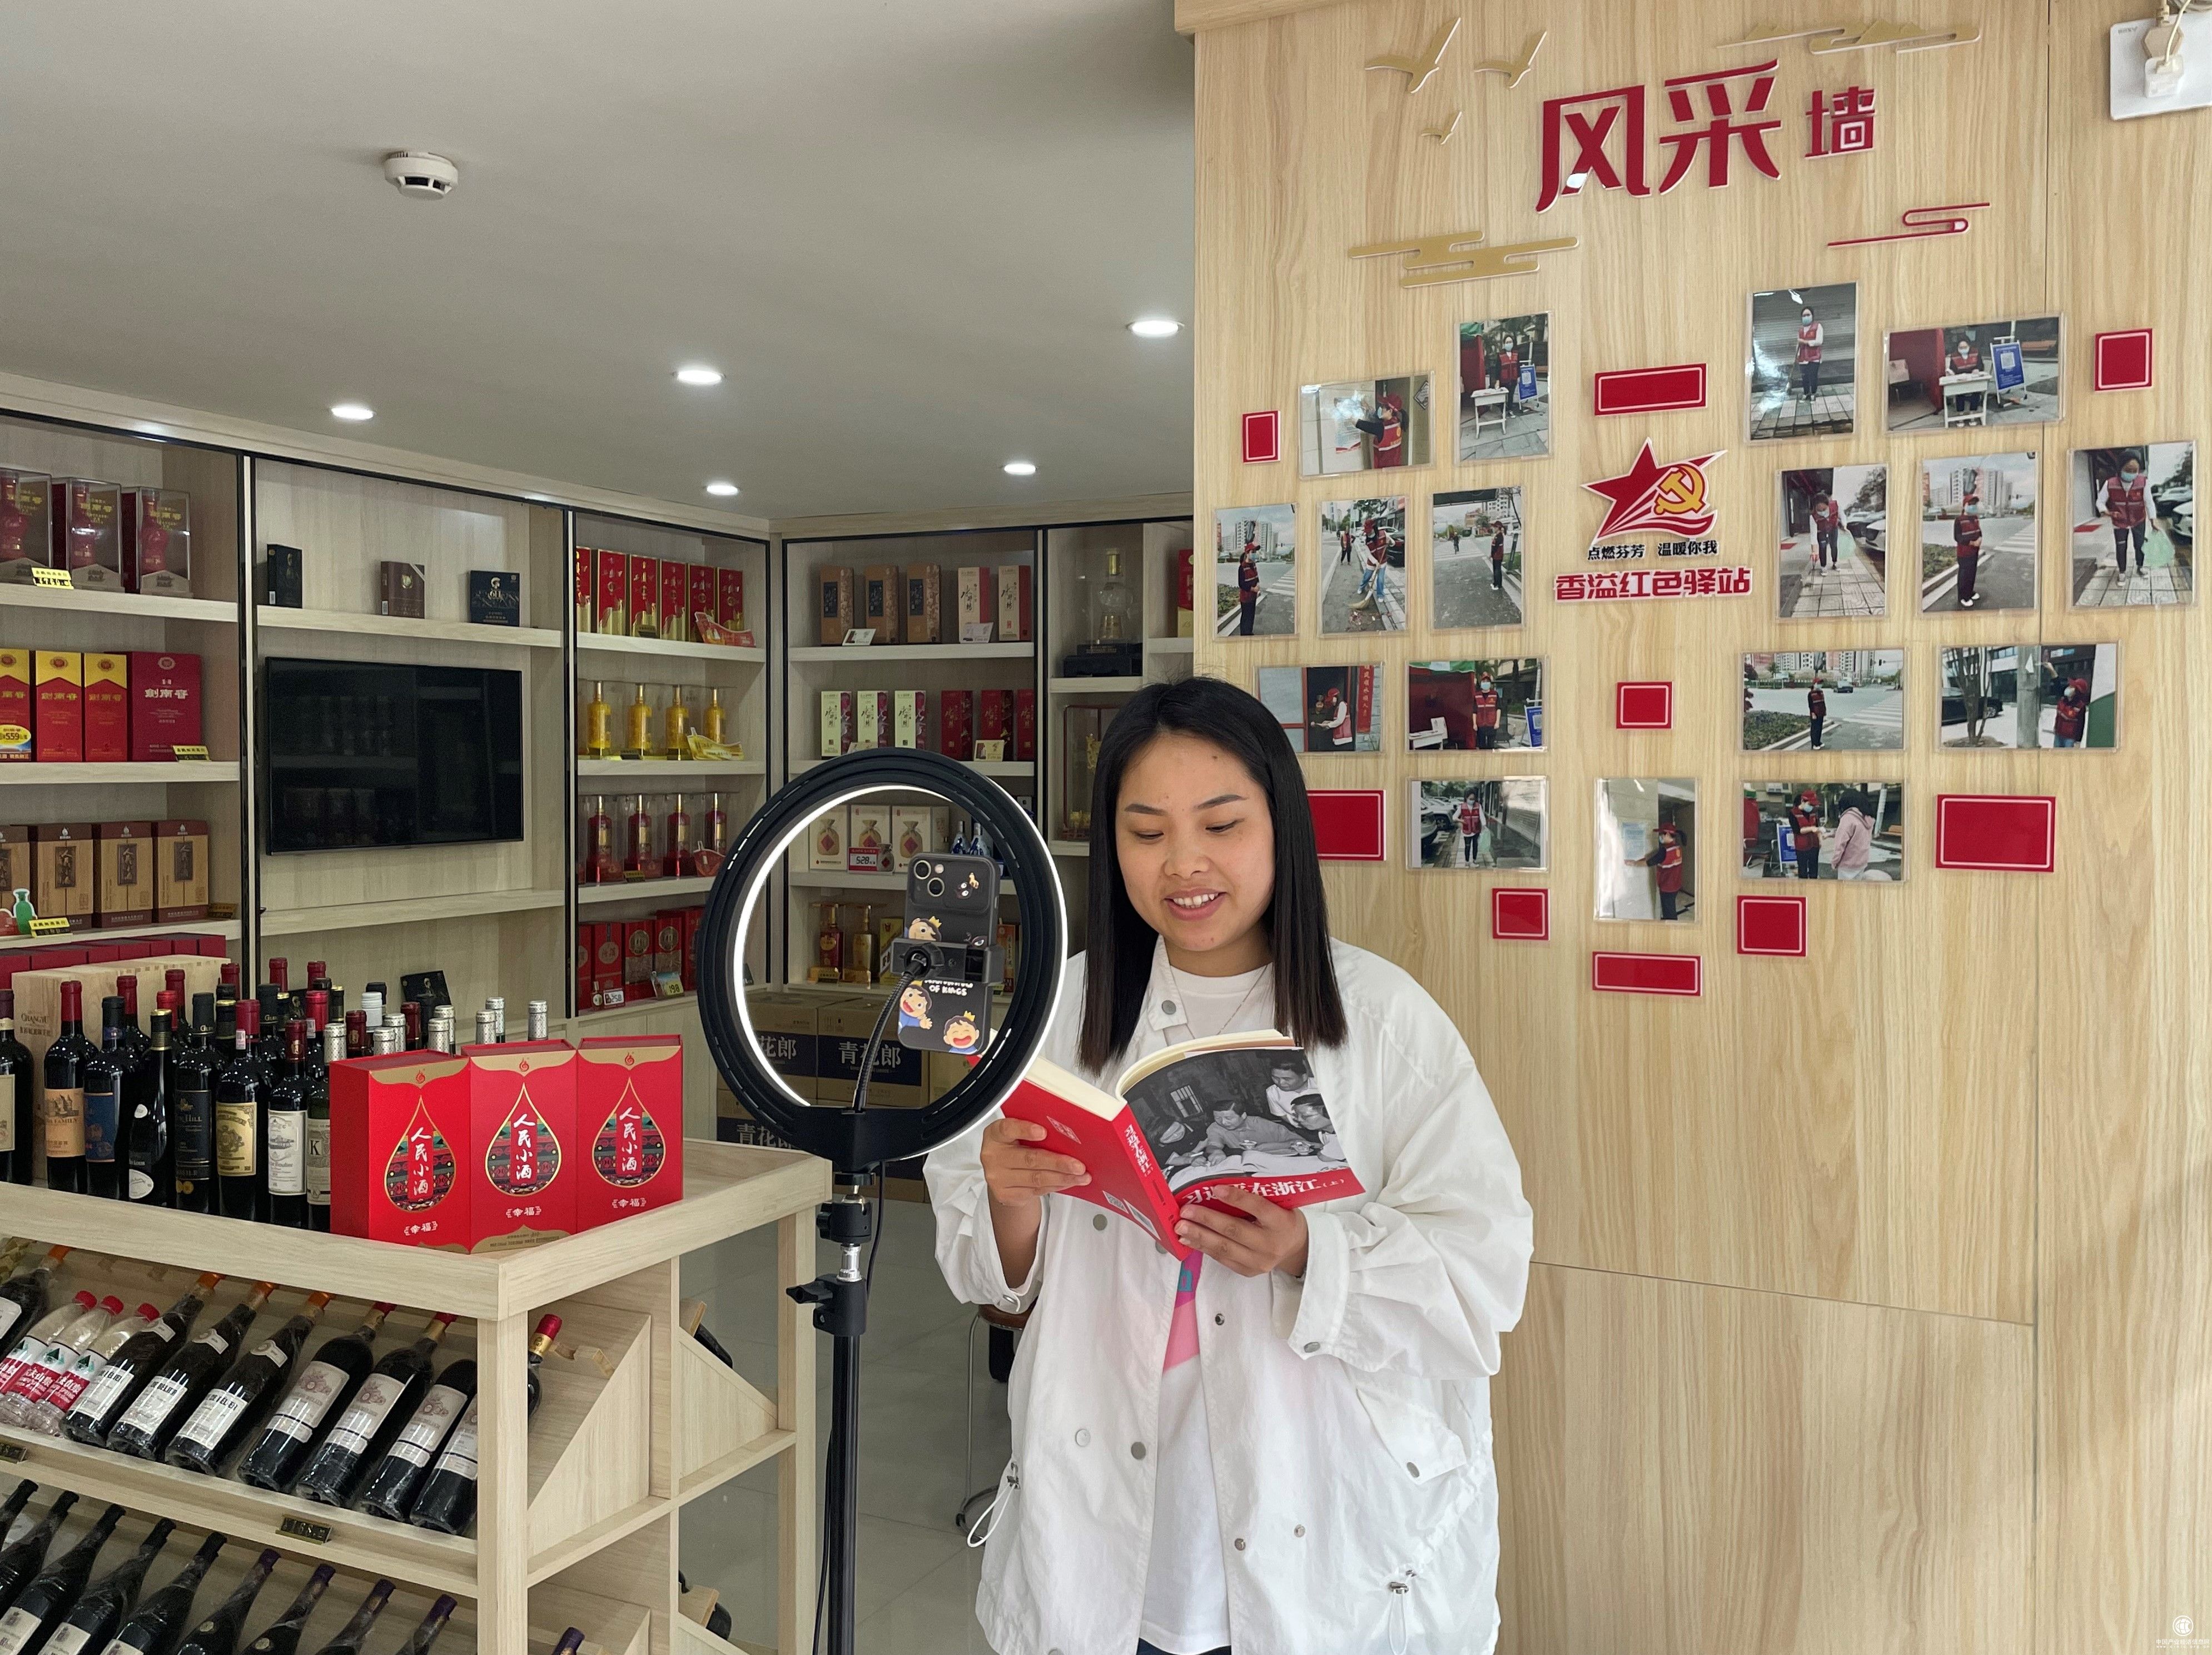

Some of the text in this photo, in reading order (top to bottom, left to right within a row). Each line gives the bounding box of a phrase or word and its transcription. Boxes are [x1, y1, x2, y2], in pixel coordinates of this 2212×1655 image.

[1536, 59, 1876, 213] 风采墙
[1588, 540, 1717, 560] 点燃芬芳 温暖你我
[1556, 568, 1751, 600] 香溢红色驿站
[856, 856, 870, 864] 528
[929, 985, 940, 993] OF
[310, 1140, 321, 1156] K
[513, 1113, 536, 1180] 人民小酒
[619, 1107, 641, 1172] 人民小酒
[410, 1127, 432, 1196] 人民小酒
